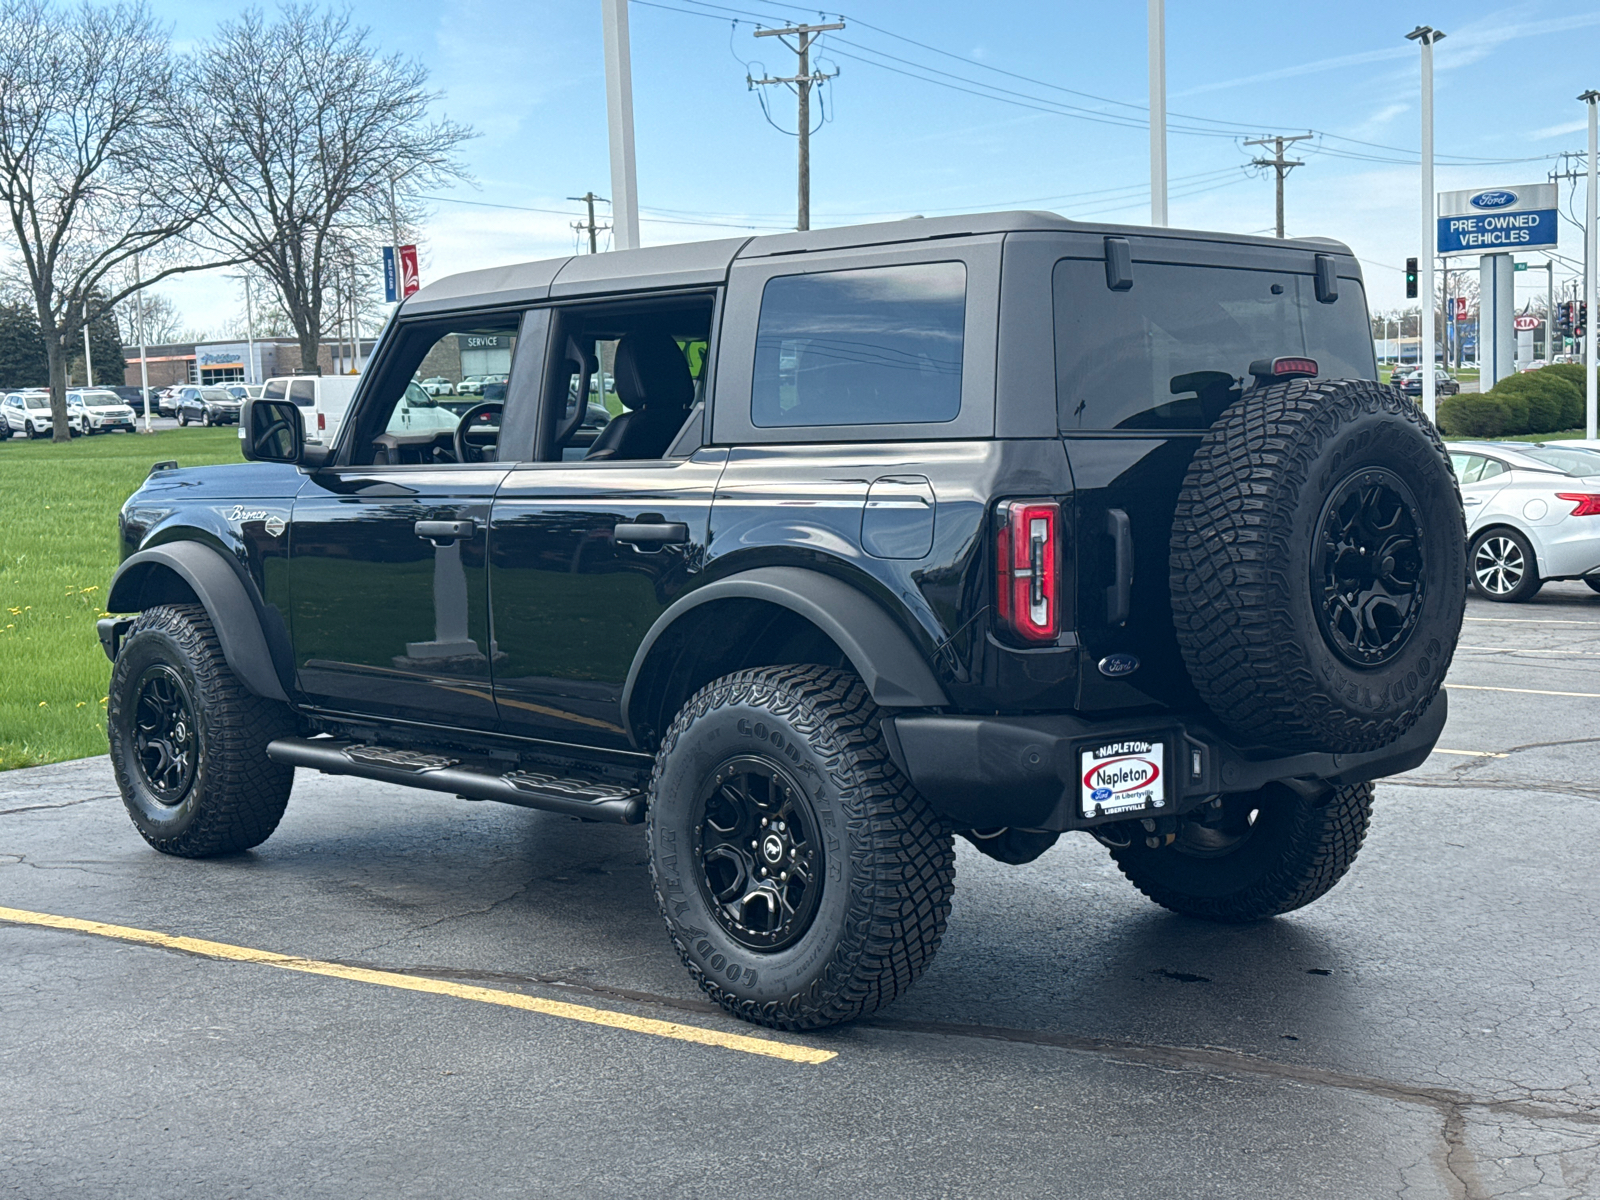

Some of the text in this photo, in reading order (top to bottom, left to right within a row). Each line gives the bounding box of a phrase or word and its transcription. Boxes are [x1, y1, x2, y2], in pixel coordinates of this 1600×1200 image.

[1479, 193, 1507, 205] Ford
[1459, 229, 1530, 246] VEHICLES
[1515, 319, 1536, 328] KIA
[467, 336, 498, 347] SERVICE
[227, 504, 268, 521] Bronco
[1109, 659, 1131, 671] Ford
[1100, 742, 1147, 757] NAPLETON
[1096, 767, 1148, 788] Napleton
[737, 718, 841, 882] GOODYEAR
[1121, 789, 1154, 800] Libertyville
[1105, 803, 1145, 815] LIBERTYVILLE
[661, 826, 759, 989] GOODYEAR
